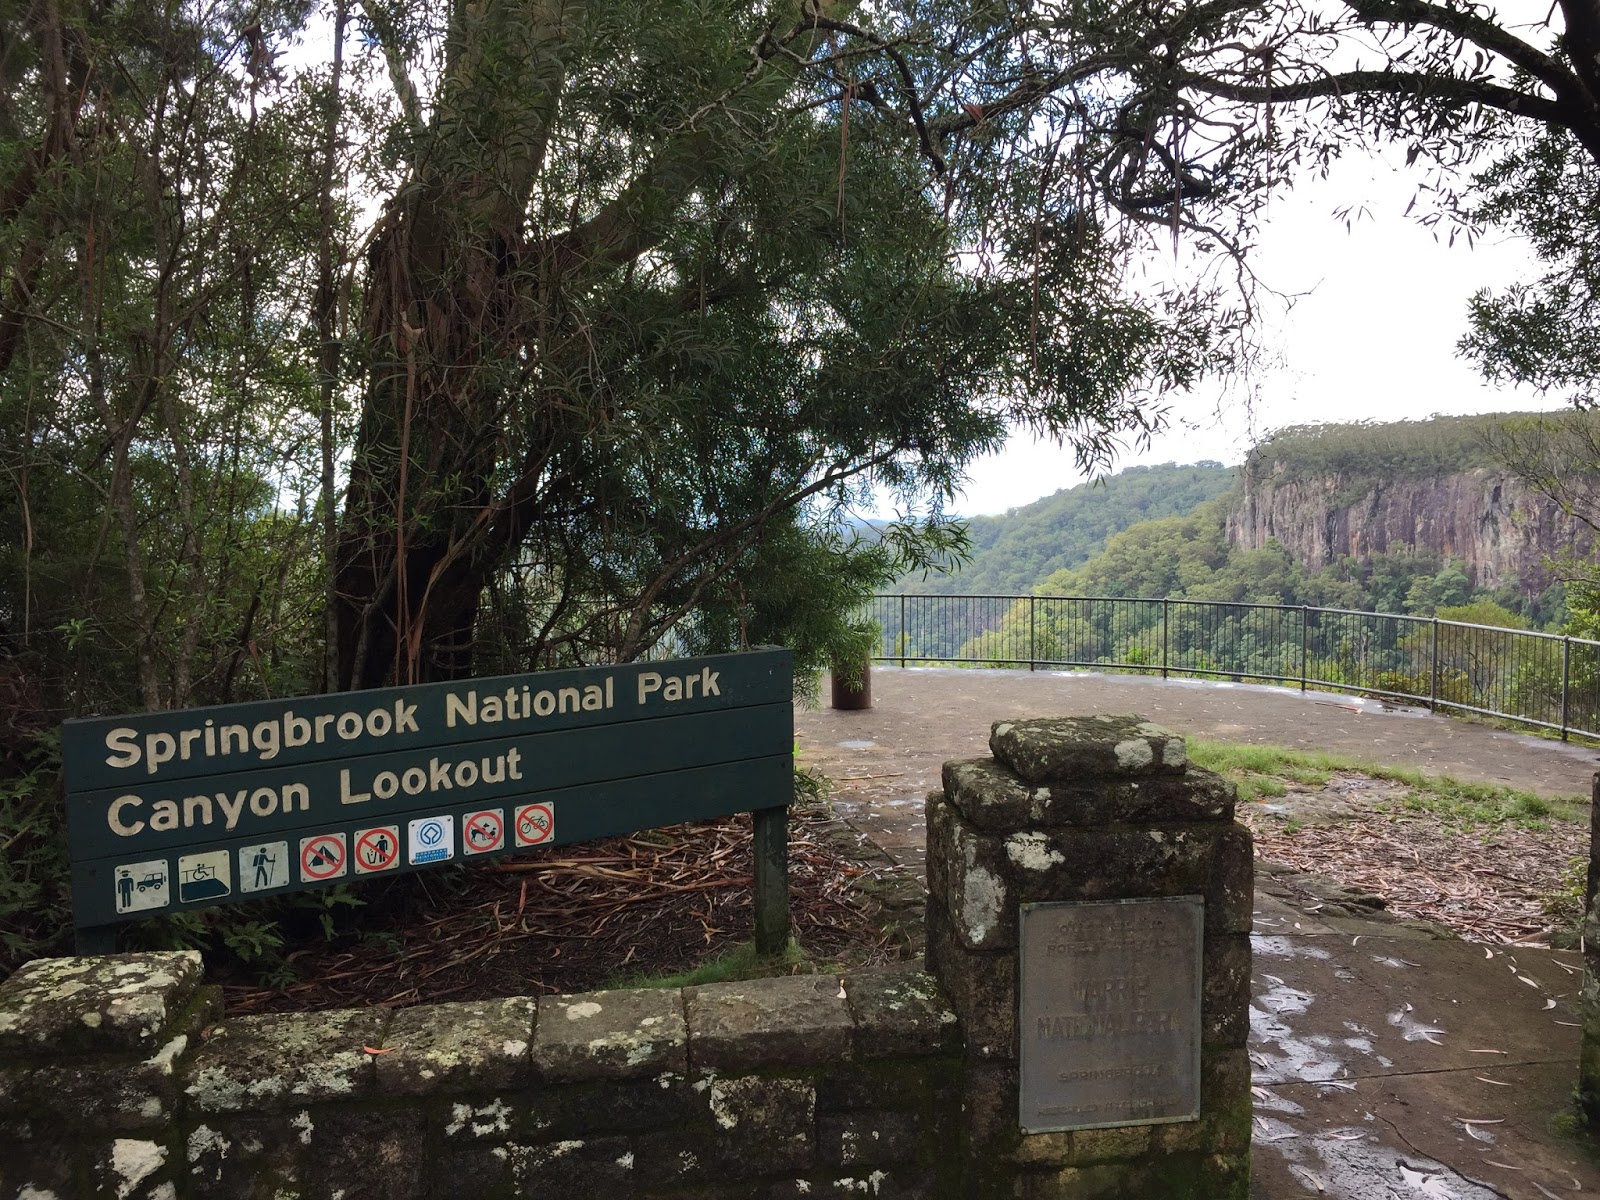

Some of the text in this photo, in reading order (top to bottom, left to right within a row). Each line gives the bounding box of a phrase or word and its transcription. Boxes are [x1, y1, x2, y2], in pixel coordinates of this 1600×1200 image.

[105, 666, 720, 775] Springbrook National Park
[108, 748, 522, 836] Canyon Lookout
